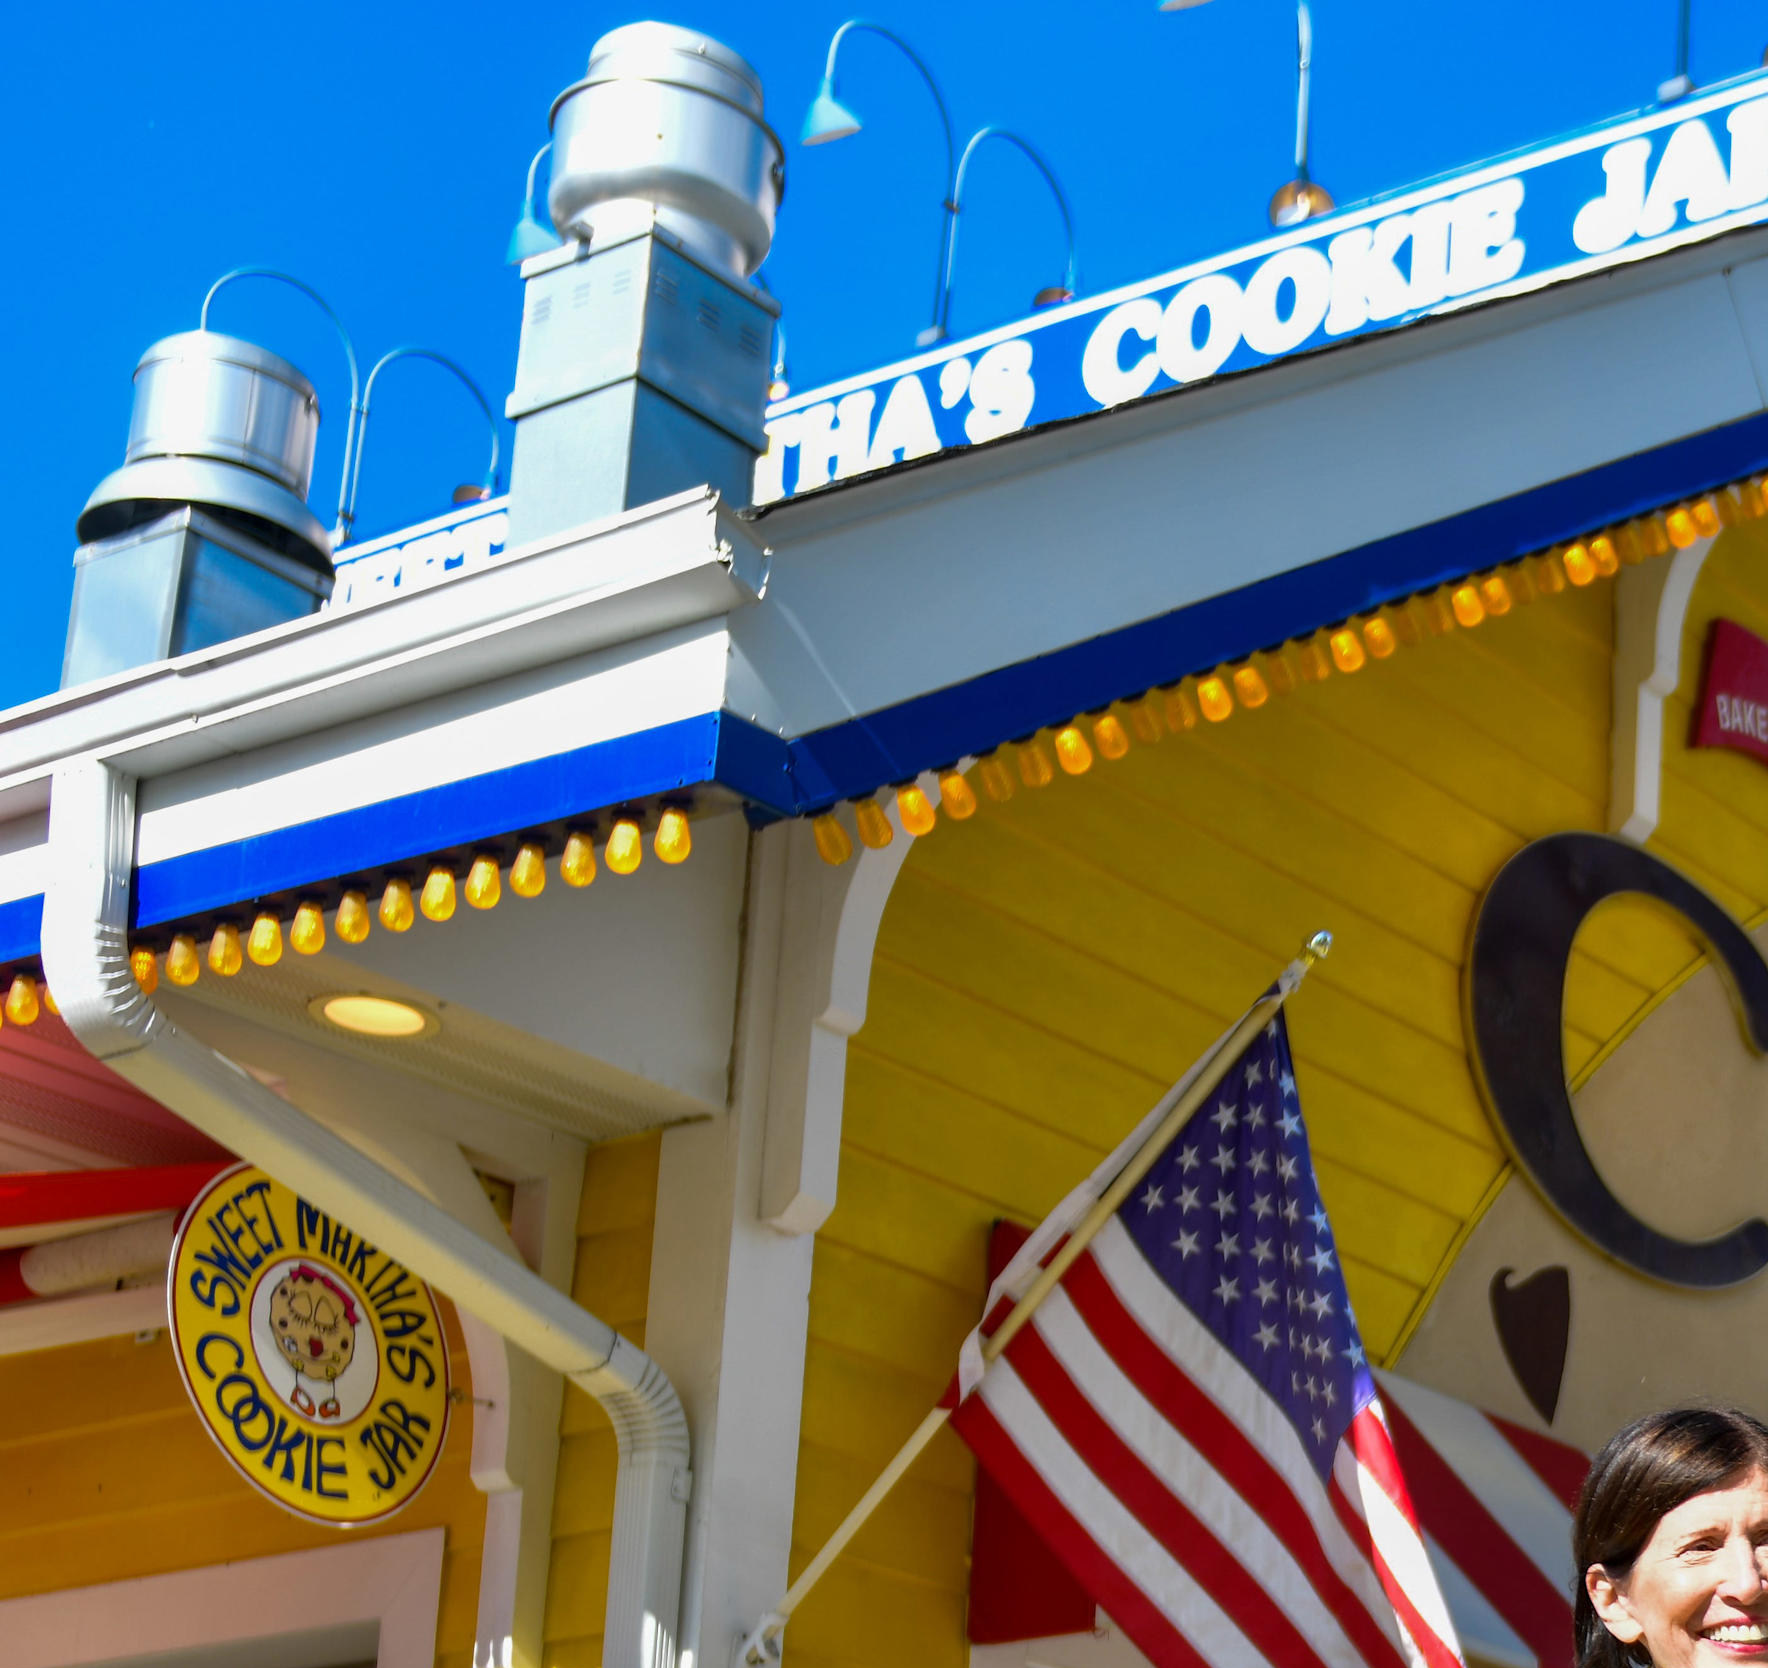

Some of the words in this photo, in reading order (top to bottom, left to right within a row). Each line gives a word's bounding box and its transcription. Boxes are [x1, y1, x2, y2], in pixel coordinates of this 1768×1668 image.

[752, 339, 1036, 507] THA'S
[1081, 177, 1526, 407] COOKIE
[190, 1179, 284, 1317] SWEET
[296, 1194, 437, 1389] MARTHA'S
[196, 1333, 350, 1501] COOKIE
[360, 1398, 432, 1490] JAR
